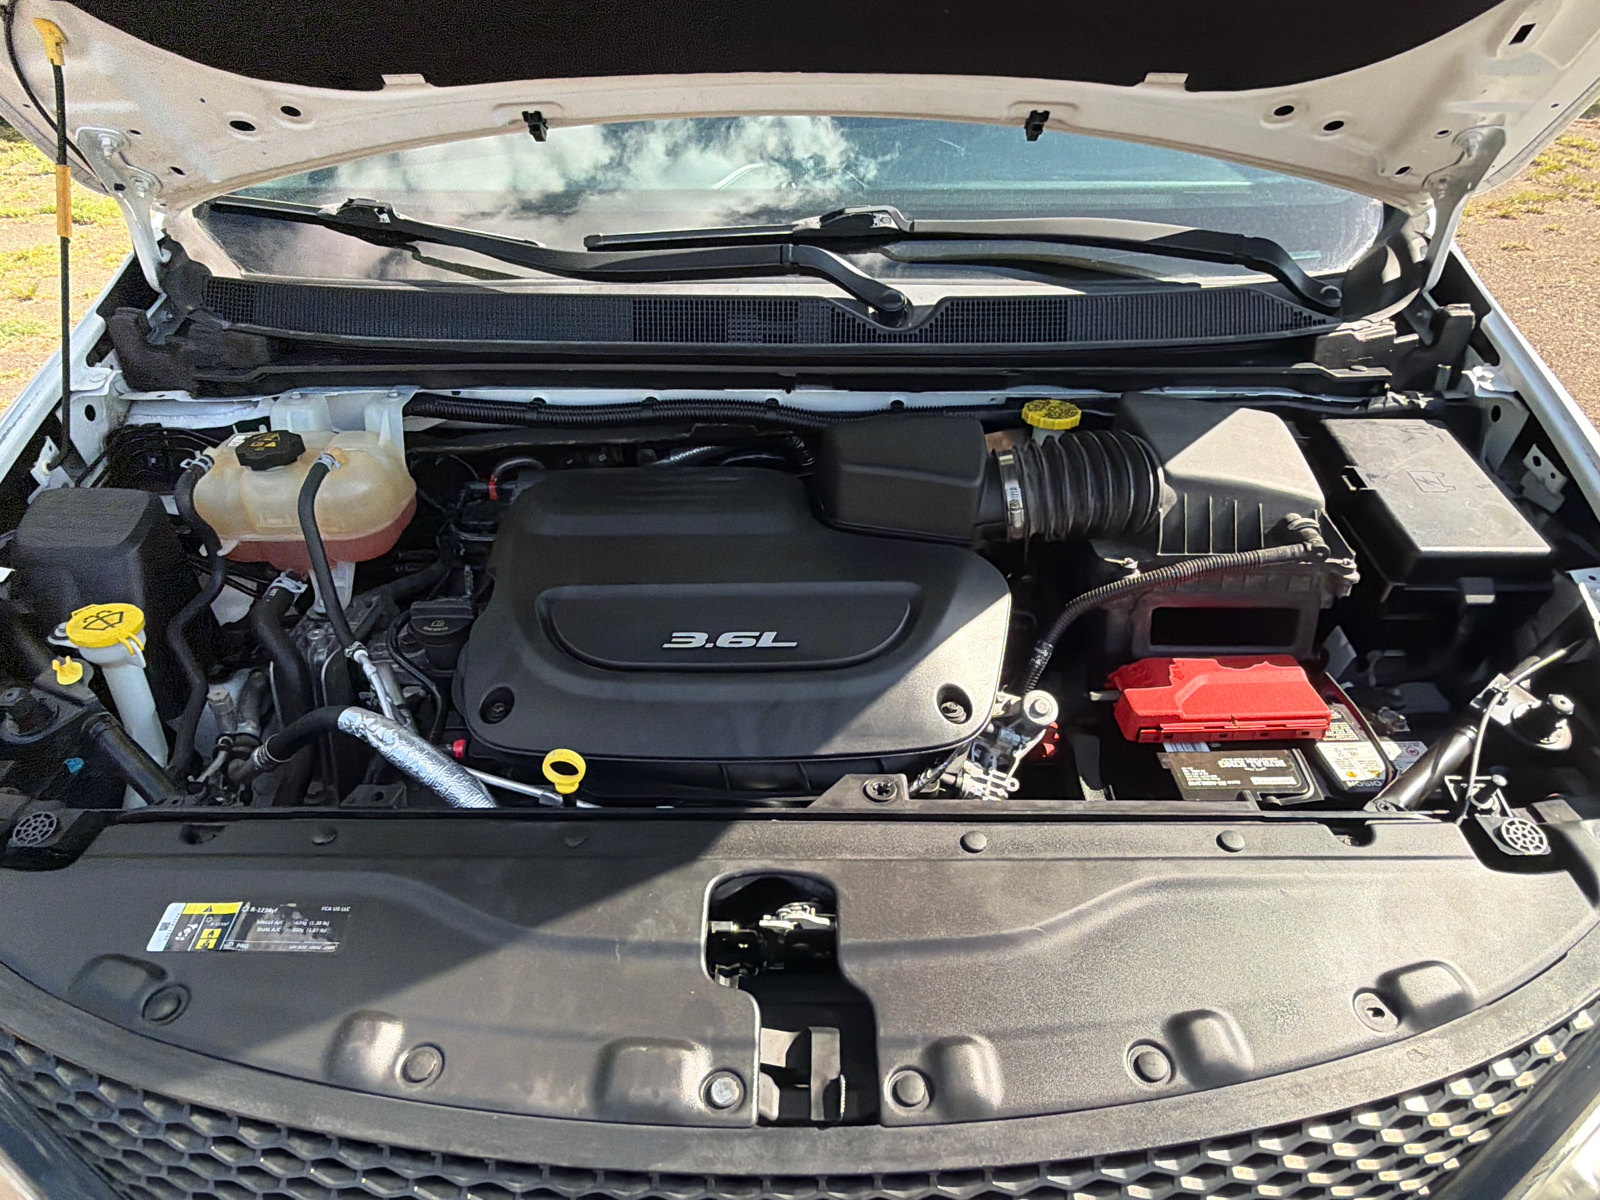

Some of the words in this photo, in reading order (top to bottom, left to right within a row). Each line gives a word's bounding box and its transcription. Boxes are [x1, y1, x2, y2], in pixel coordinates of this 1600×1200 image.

[661, 631, 798, 648] 3.6L
[1218, 759, 1247, 768] KING
[1246, 759, 1287, 768] RURAL
